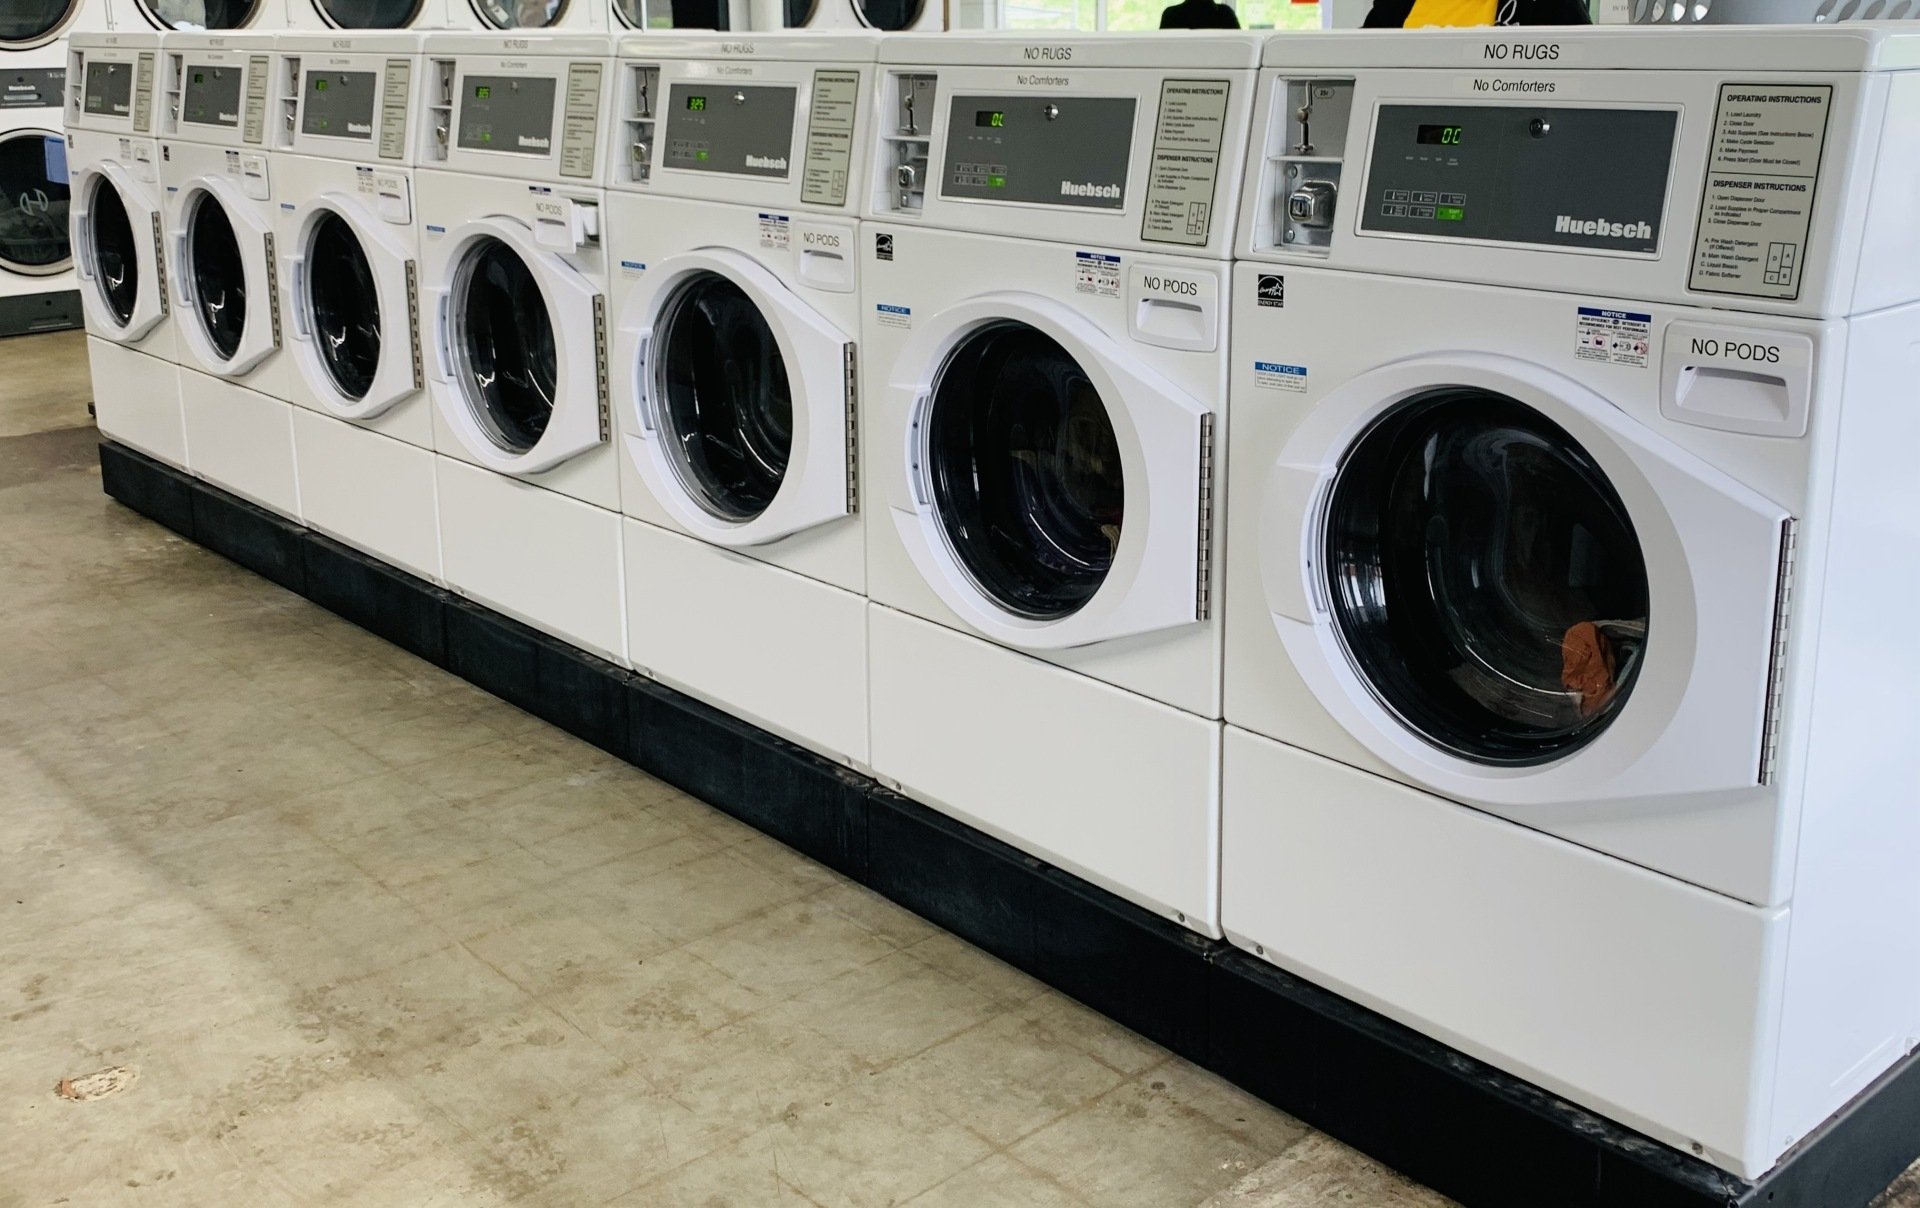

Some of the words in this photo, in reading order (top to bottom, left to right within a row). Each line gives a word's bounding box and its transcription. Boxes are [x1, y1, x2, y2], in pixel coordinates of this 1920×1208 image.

[1024, 47, 1040, 60] NO
[1042, 47, 1072, 60] RUGS
[1484, 44, 1507, 59] NO
[1512, 44, 1560, 60] RUGS
[1017, 75, 1027, 85] No
[1029, 75, 1069, 86] Comforters
[1473, 79, 1489, 91] No
[1493, 79, 1556, 92] Comforters
[1727, 94, 1767, 102] OPERATING
[1768, 96, 1822, 104] INSTRUCTIONS
[1061, 181, 1120, 198] Huebsch
[1713, 180, 1752, 189] DISPENSER
[1754, 182, 1806, 192] INSTRUCTIONS
[1555, 215, 1652, 239] Huebsch
[804, 232, 815, 243] NO
[816, 234, 840, 247] PODS
[1144, 276, 1160, 290] NO
[1164, 279, 1197, 295] PODS
[1691, 338, 1718, 356] NO
[1724, 342, 1780, 363] PODS
[1262, 363, 1300, 374] NOTICE
